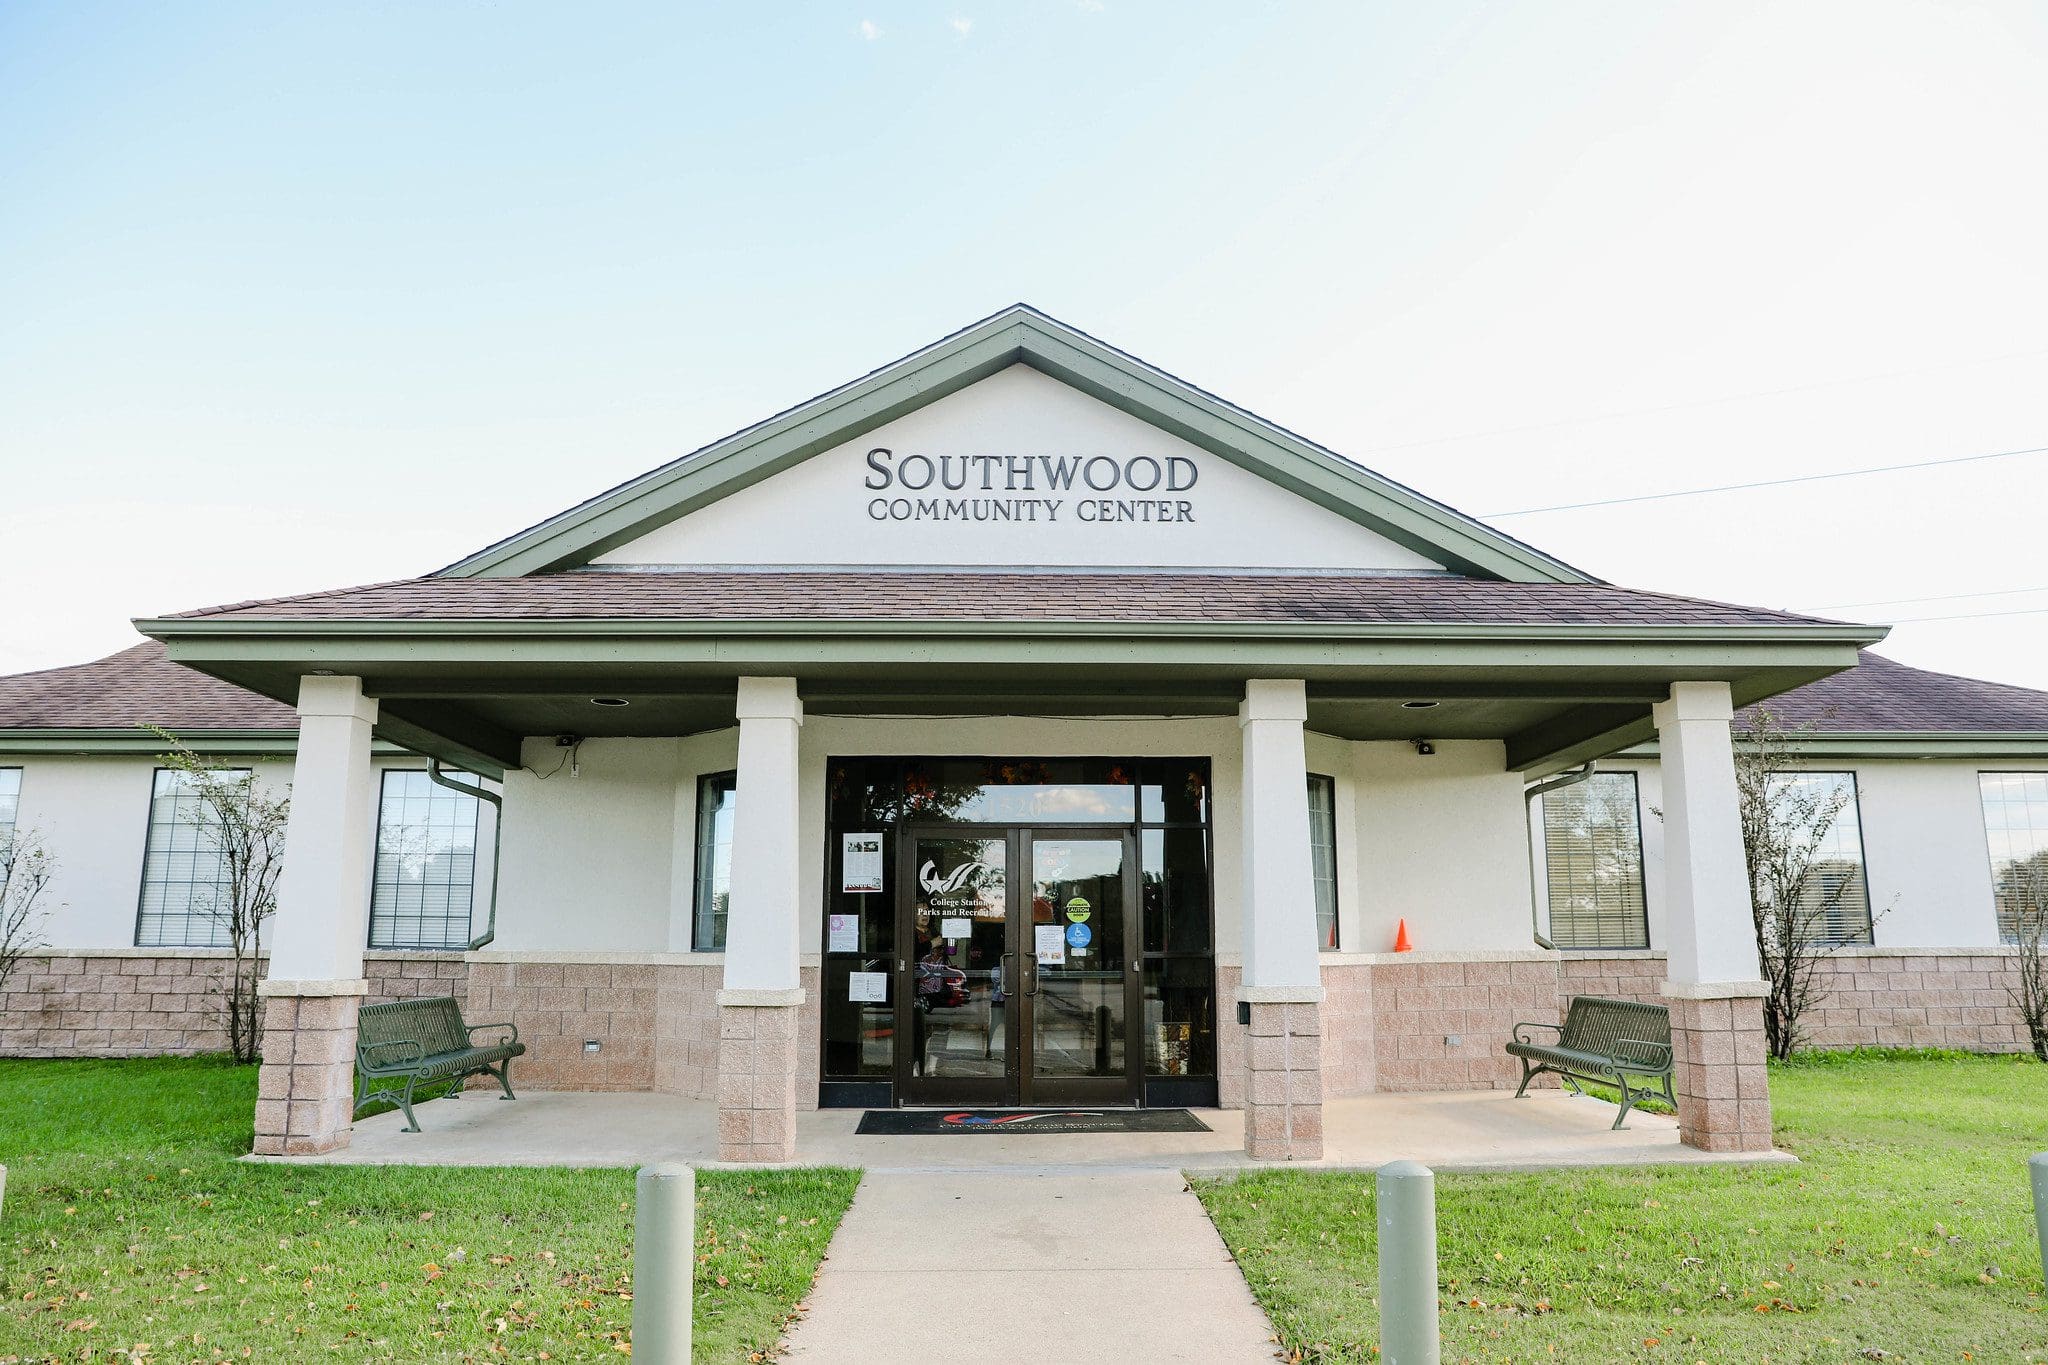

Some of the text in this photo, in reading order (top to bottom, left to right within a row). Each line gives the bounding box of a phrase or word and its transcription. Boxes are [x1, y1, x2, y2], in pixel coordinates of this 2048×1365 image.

[864, 447, 1199, 492] SOUTHWOOD
[867, 498, 1196, 523] COMMUNITY CENTER
[930, 898, 959, 908] College
[917, 908, 941, 916] Parks
[942, 908, 957, 916] and
